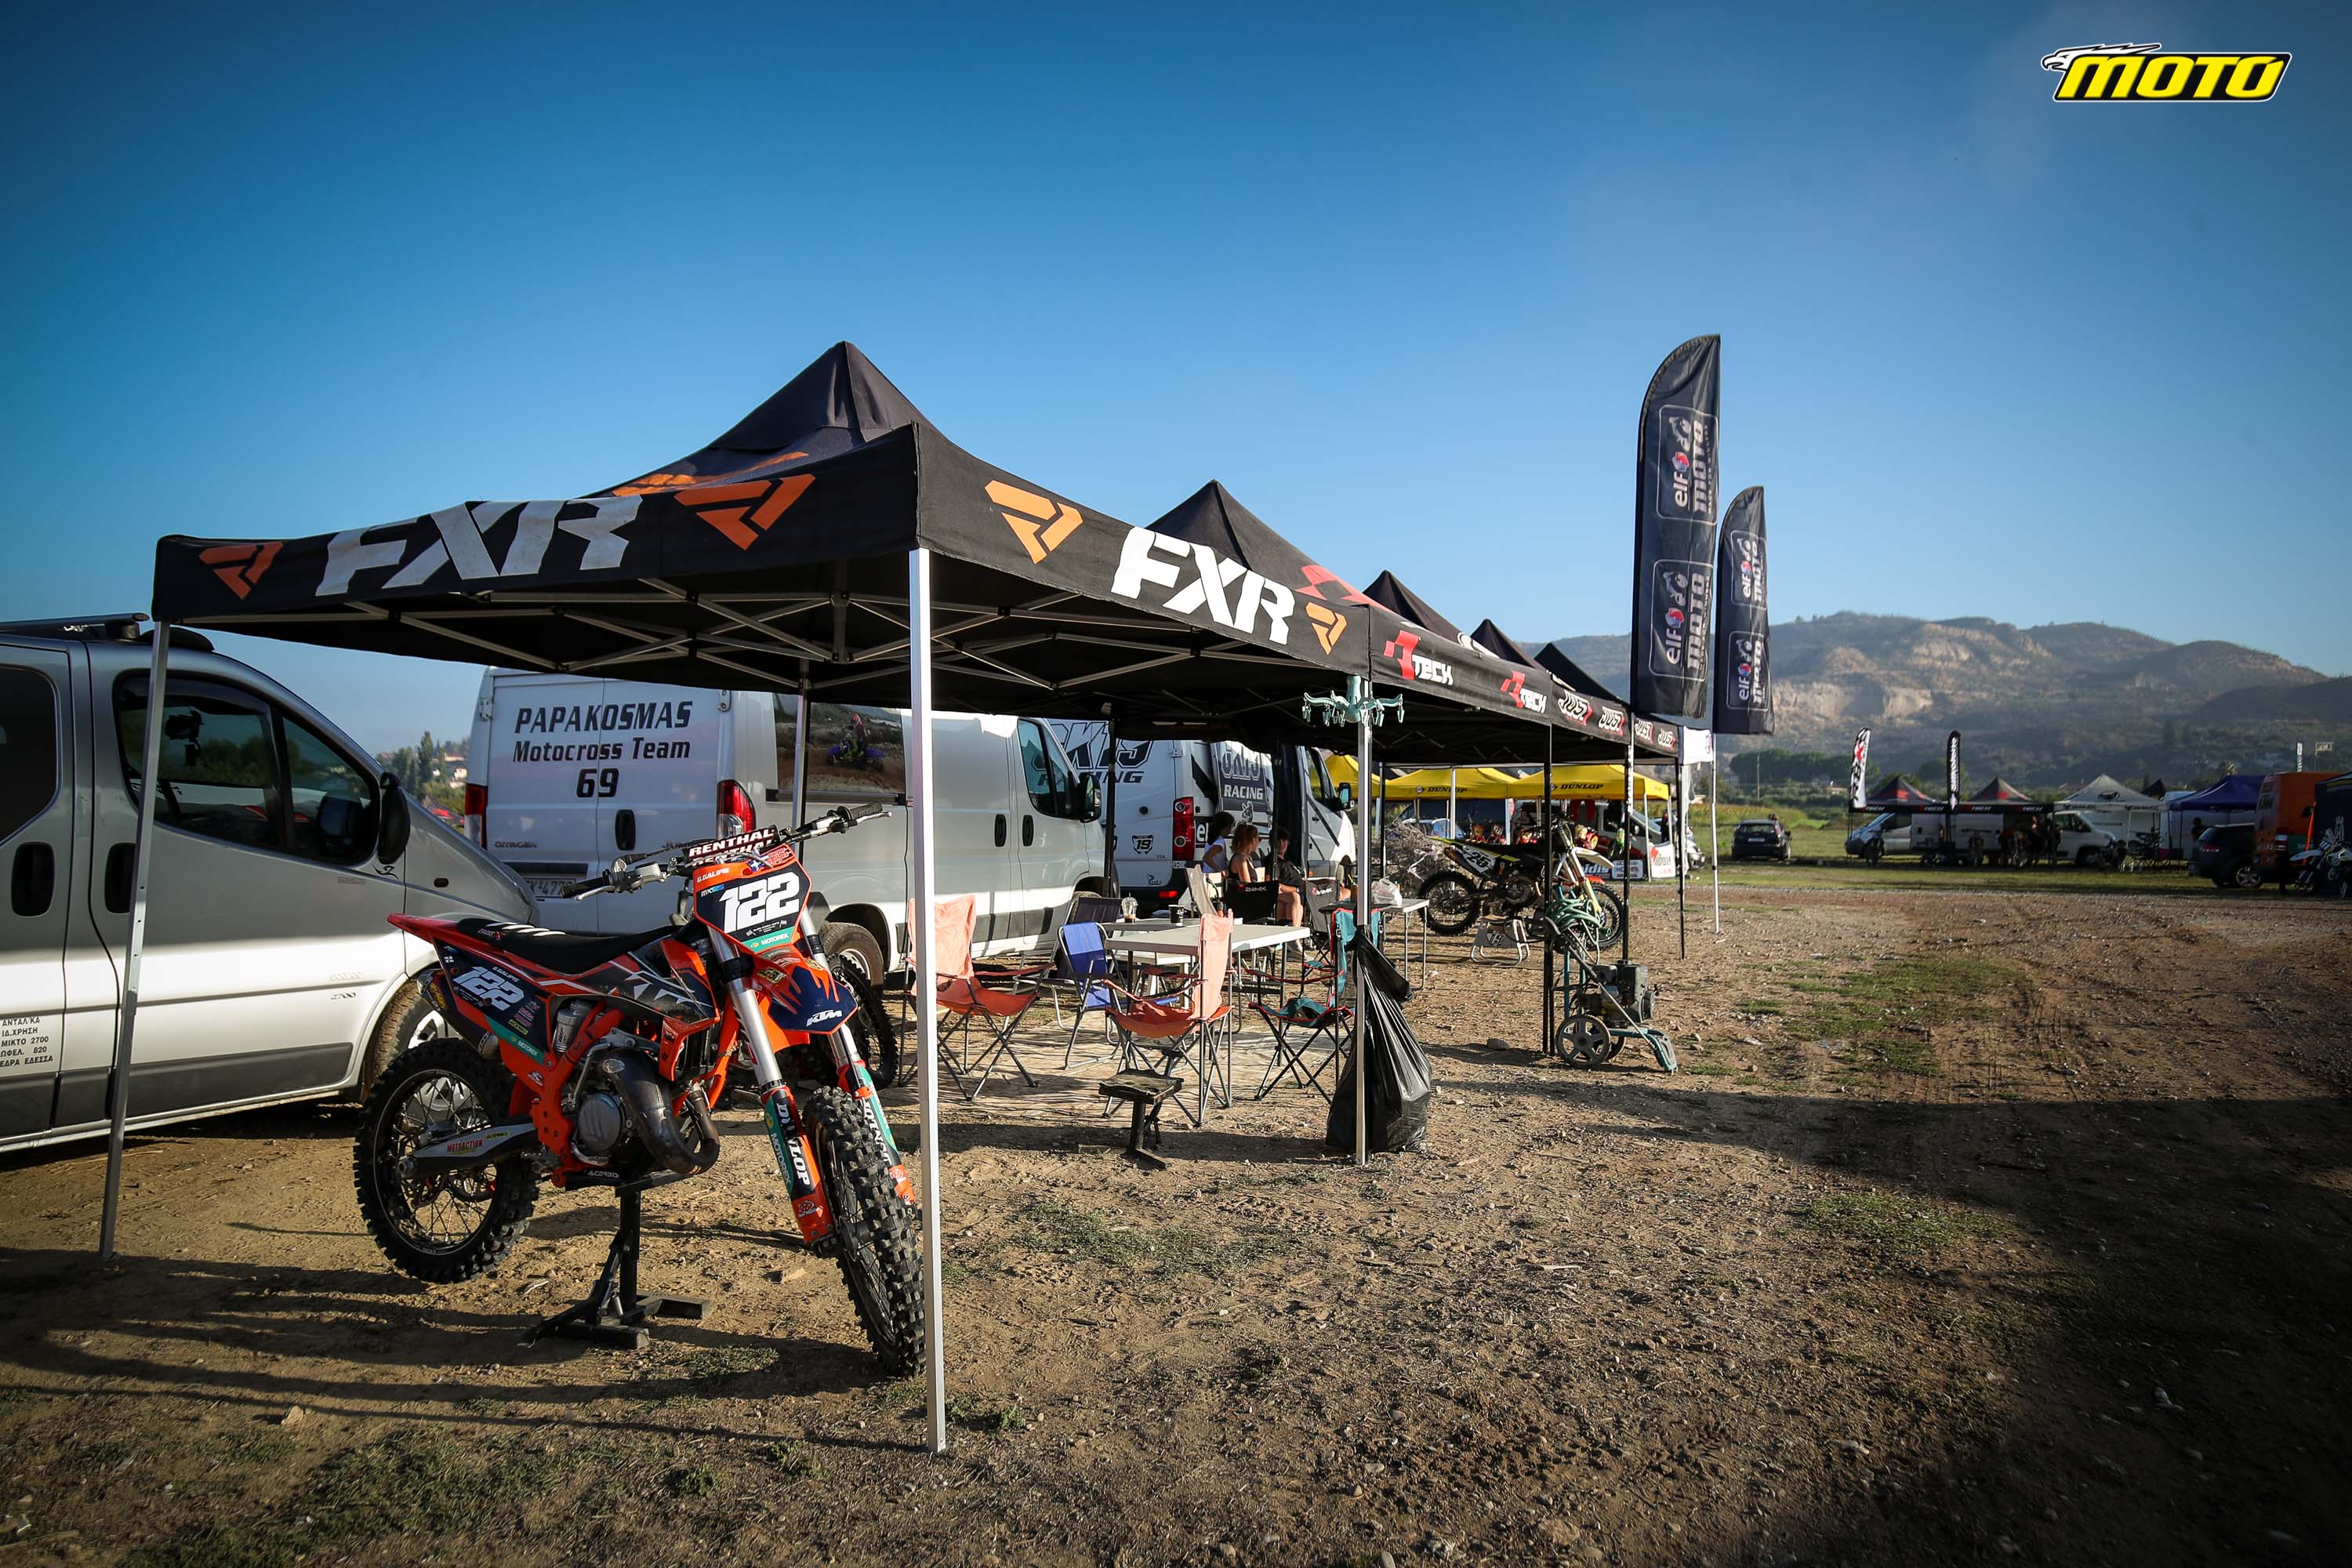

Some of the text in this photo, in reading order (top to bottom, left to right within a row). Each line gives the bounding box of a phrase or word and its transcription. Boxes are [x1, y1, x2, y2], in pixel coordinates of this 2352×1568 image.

[1674, 472, 1688, 508] elf
[315, 495, 644, 597] FXR
[1111, 526, 1294, 644] FXR
[1665, 627, 1682, 665] elf
[1738, 675, 1749, 700] elf
[514, 701, 693, 733] PAPAKOSMAS
[513, 737, 691, 763] Motocross Team
[576, 768, 619, 798] 69
[1224, 784, 1264, 800] RACING
[689, 829, 775, 856] RENTHAL
[1137, 839, 1152, 850] 19
[719, 872, 800, 934] 122
[760, 933, 789, 946] MOTOREX
[452, 966, 524, 1011] 122
[807, 1010, 843, 1027] KTM
[2, 1036, 49, 1047] ΜΙΚΤΟ 2700
[517, 1040, 538, 1057] MOTOREX
[25, 1055, 53, 1064] ΕΔΕΣΣΑ
[770, 1133, 792, 1185] MOTOREX
